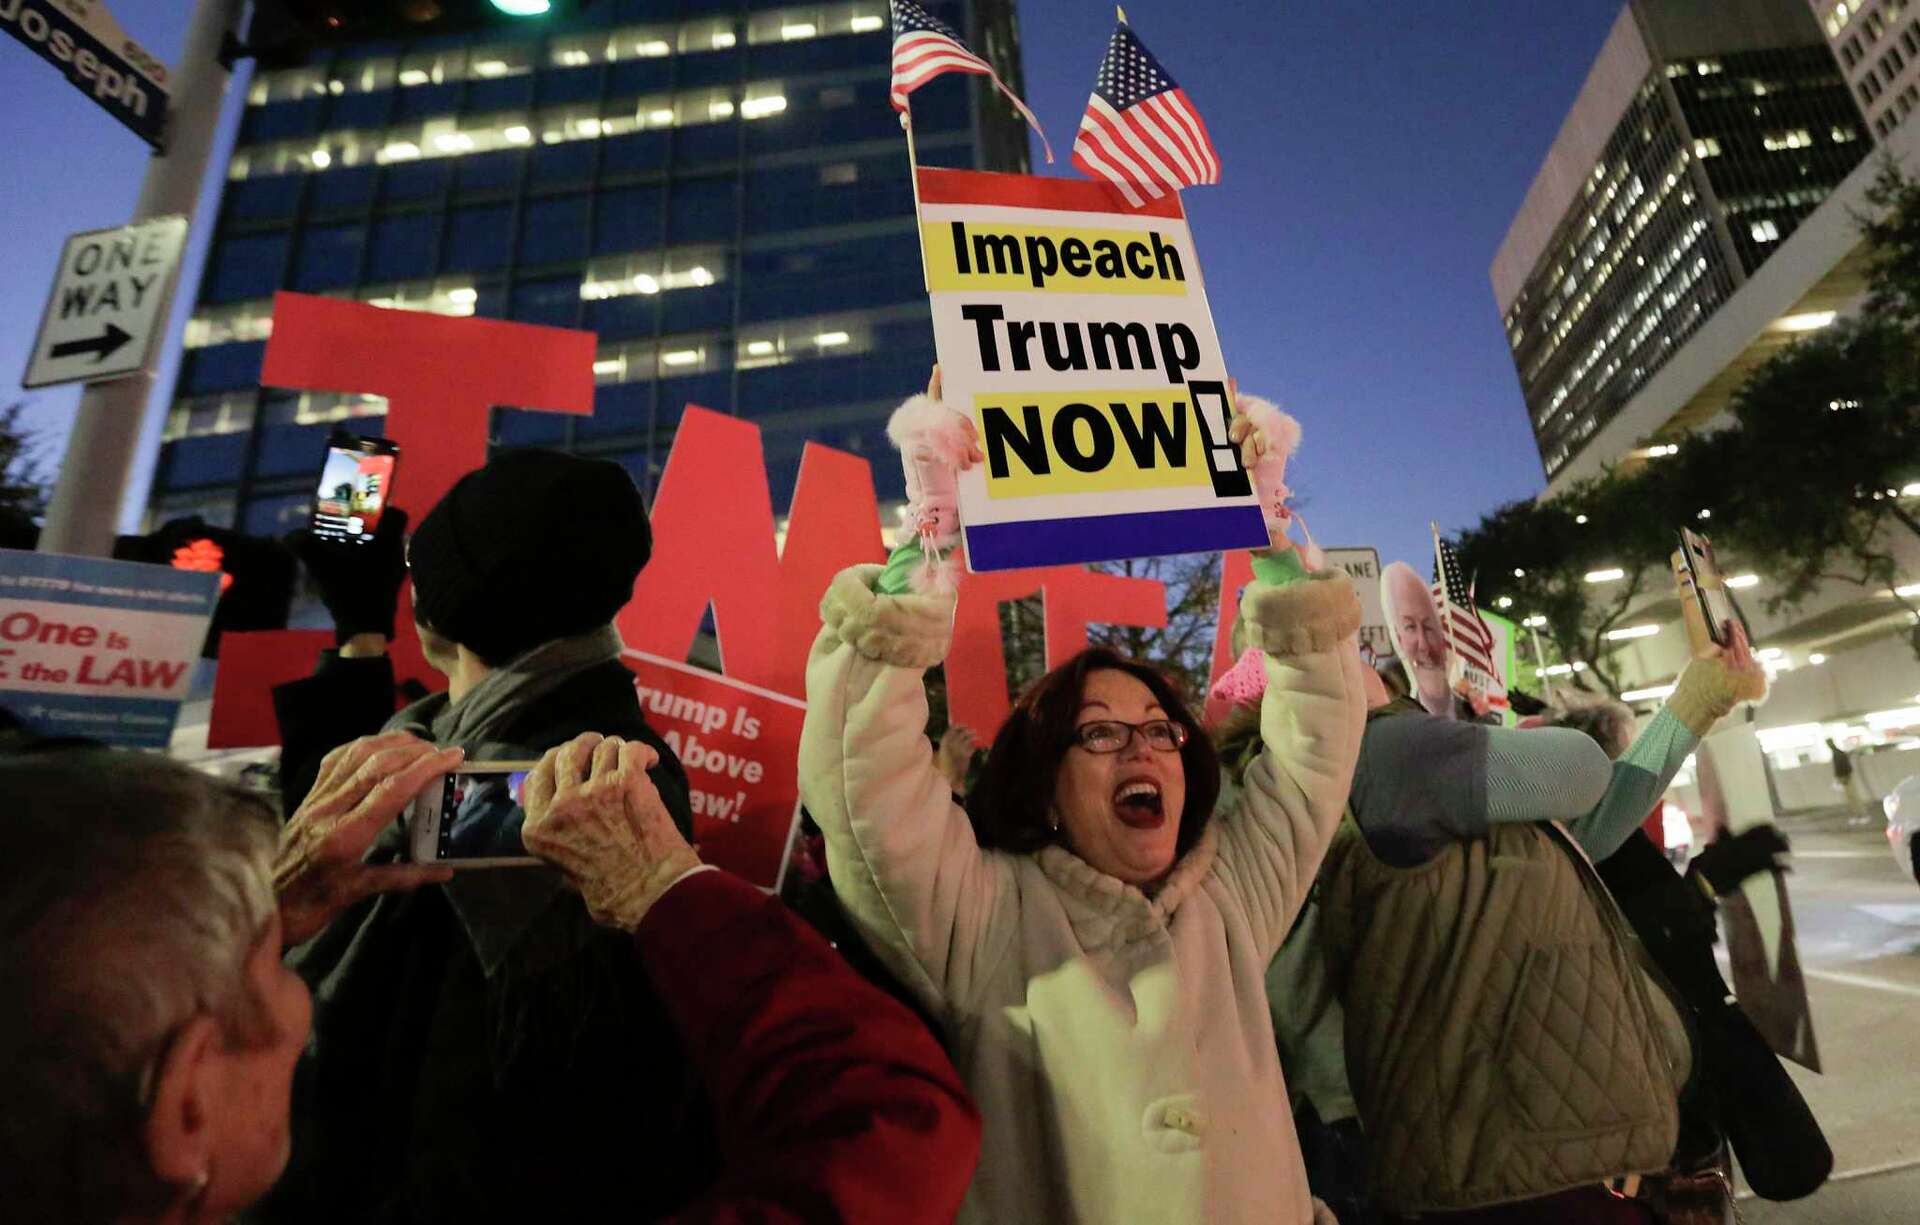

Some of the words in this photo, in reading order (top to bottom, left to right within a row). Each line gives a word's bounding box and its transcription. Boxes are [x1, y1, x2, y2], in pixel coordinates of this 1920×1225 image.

[74, 232, 162, 276] ONE
[951, 221, 1186, 288] Impeach
[61, 273, 157, 319] WAY
[961, 304, 1201, 384] Trump
[0, 612, 98, 647] One
[1359, 624, 1386, 643] EFT
[21, 663, 68, 683] the
[77, 655, 188, 689] LAW
[632, 677, 728, 735] rump
[732, 706, 761, 740] Is
[664, 729, 764, 784] Above
[689, 789, 747, 824] aw!
